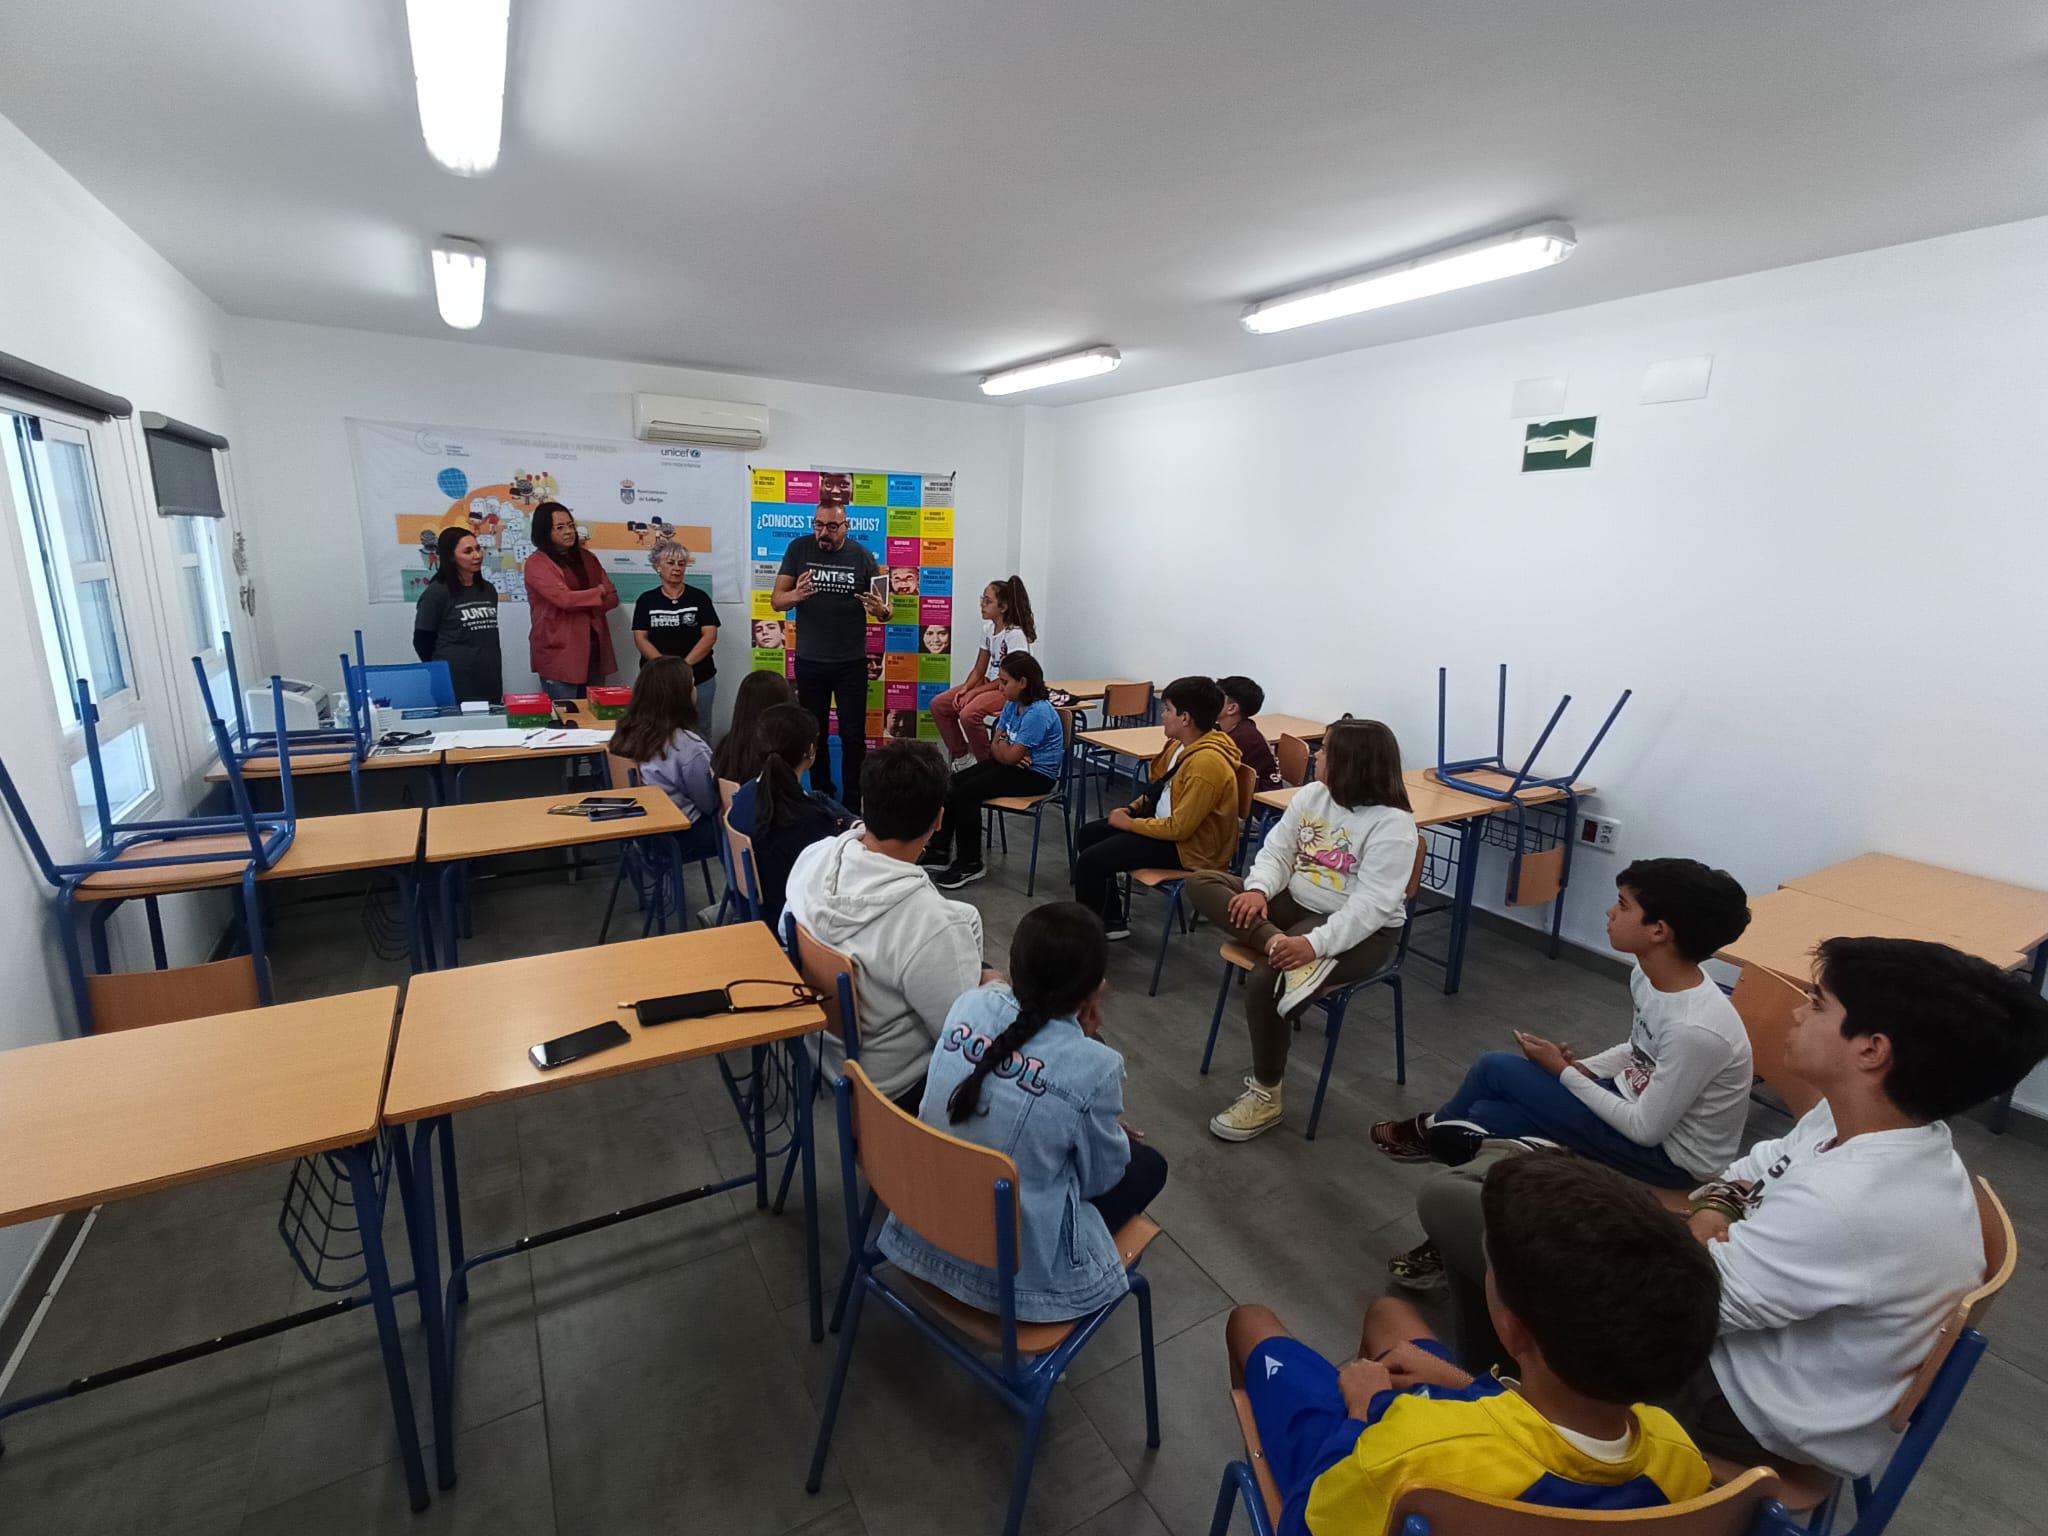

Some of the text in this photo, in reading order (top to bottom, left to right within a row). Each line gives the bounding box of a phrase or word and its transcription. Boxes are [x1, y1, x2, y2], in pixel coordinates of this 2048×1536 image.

[661, 448, 690, 458] unicef
[757, 513, 805, 531] ¿CONOCES
[847, 517, 880, 532] ECHOS?
[943, 1023, 1047, 1097] COOL
